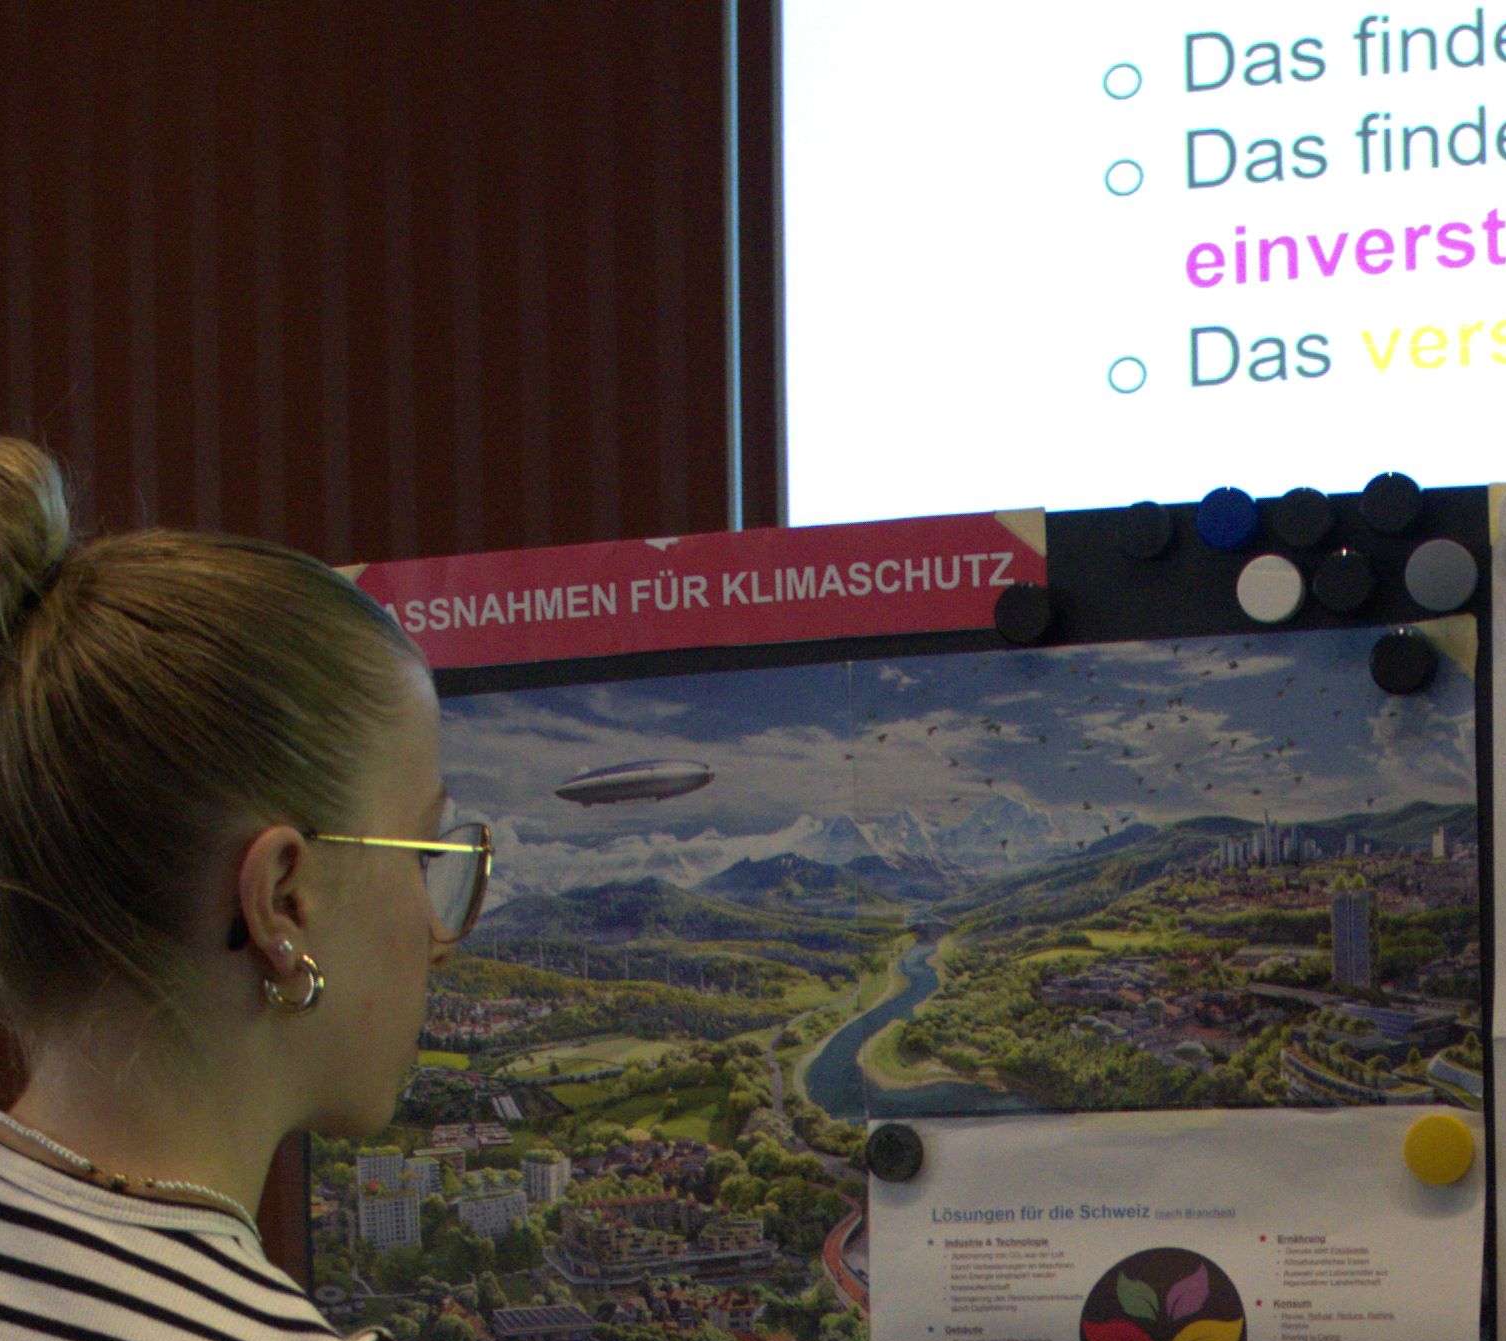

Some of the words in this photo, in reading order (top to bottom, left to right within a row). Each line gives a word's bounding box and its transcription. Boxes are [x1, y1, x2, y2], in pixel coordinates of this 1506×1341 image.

[1184, 31, 1327, 92] Das
[1184, 127, 1329, 189] Das
[1189, 326, 1332, 388] Das
[386, 583, 616, 633] ASSNAHMEN
[631, 570, 707, 612] FÜR
[722, 552, 1015, 605] KLIMASCHUTZ
[932, 1206, 1014, 1224] Lösungen
[1021, 1206, 1043, 1221] für
[1049, 1206, 1074, 1220] die
[1079, 1204, 1150, 1220] Schweiz
[945, 1238, 983, 1248] Industrie
